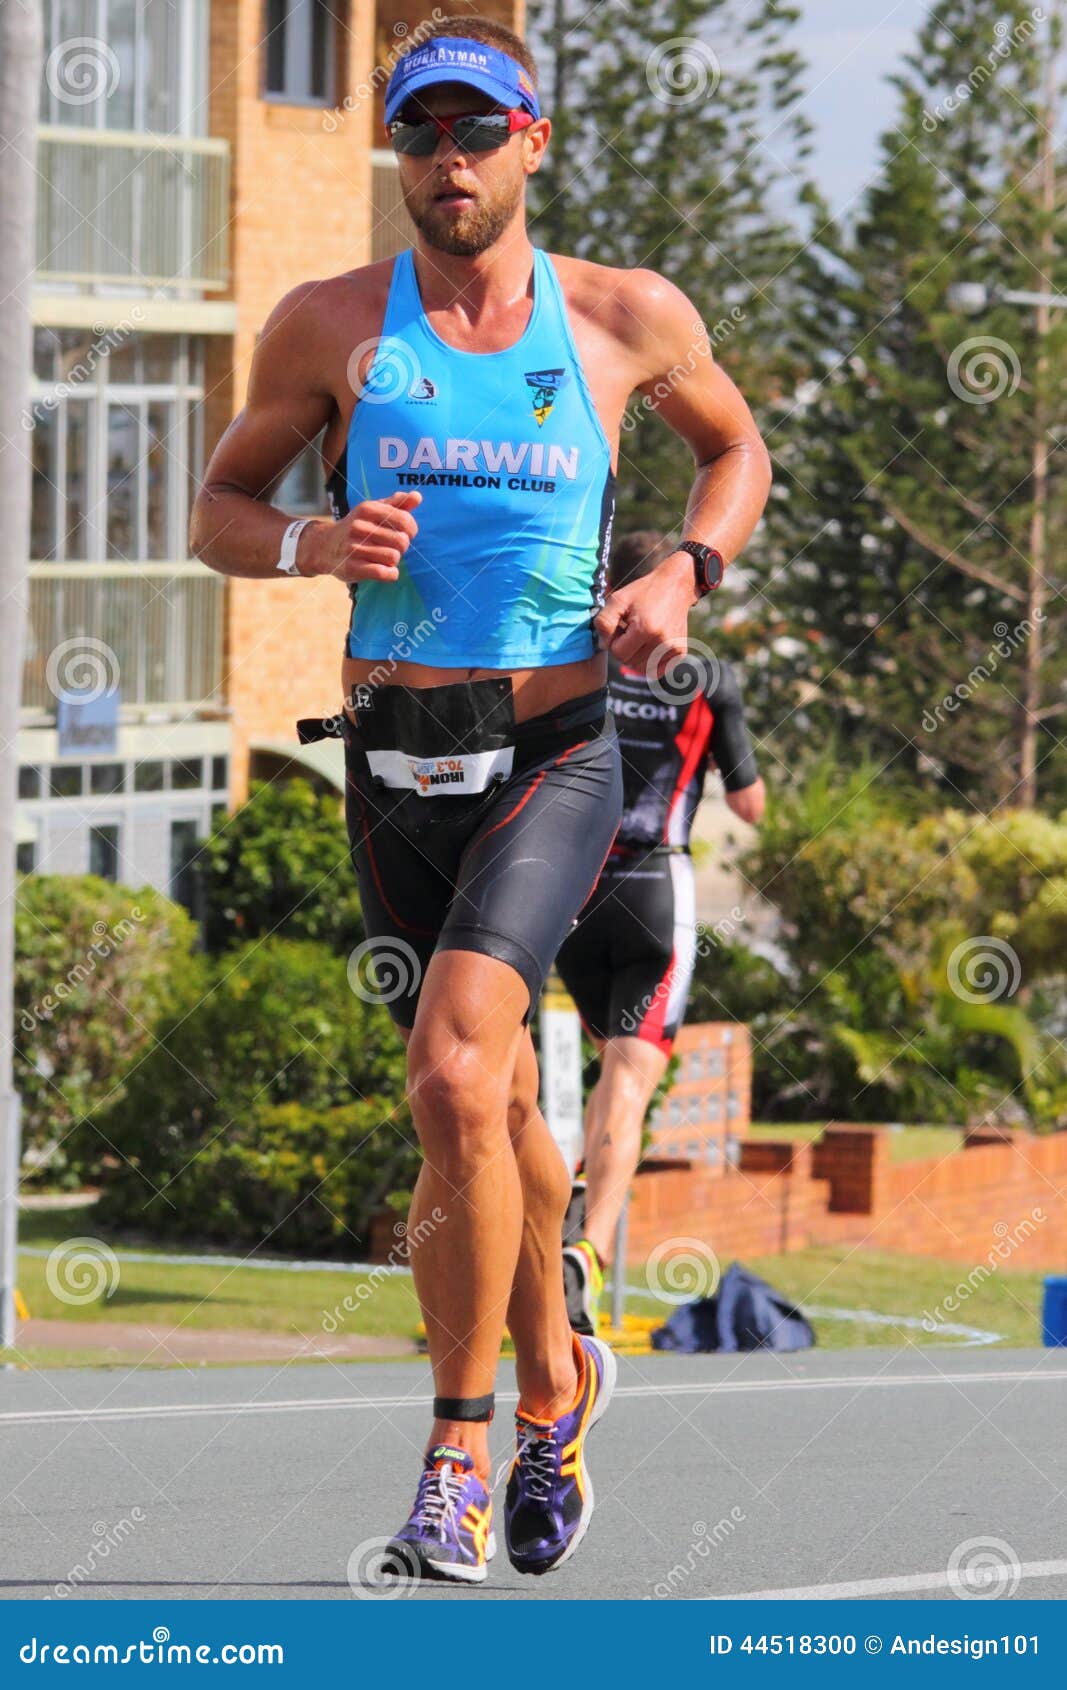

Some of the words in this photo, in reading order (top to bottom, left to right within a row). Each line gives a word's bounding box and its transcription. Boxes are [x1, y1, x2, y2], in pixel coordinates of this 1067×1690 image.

[378, 437, 579, 480] DARWIN
[396, 473, 501, 489] TRIATHLON
[508, 477, 556, 493] CLUB
[436, 759, 464, 774] 70.3
